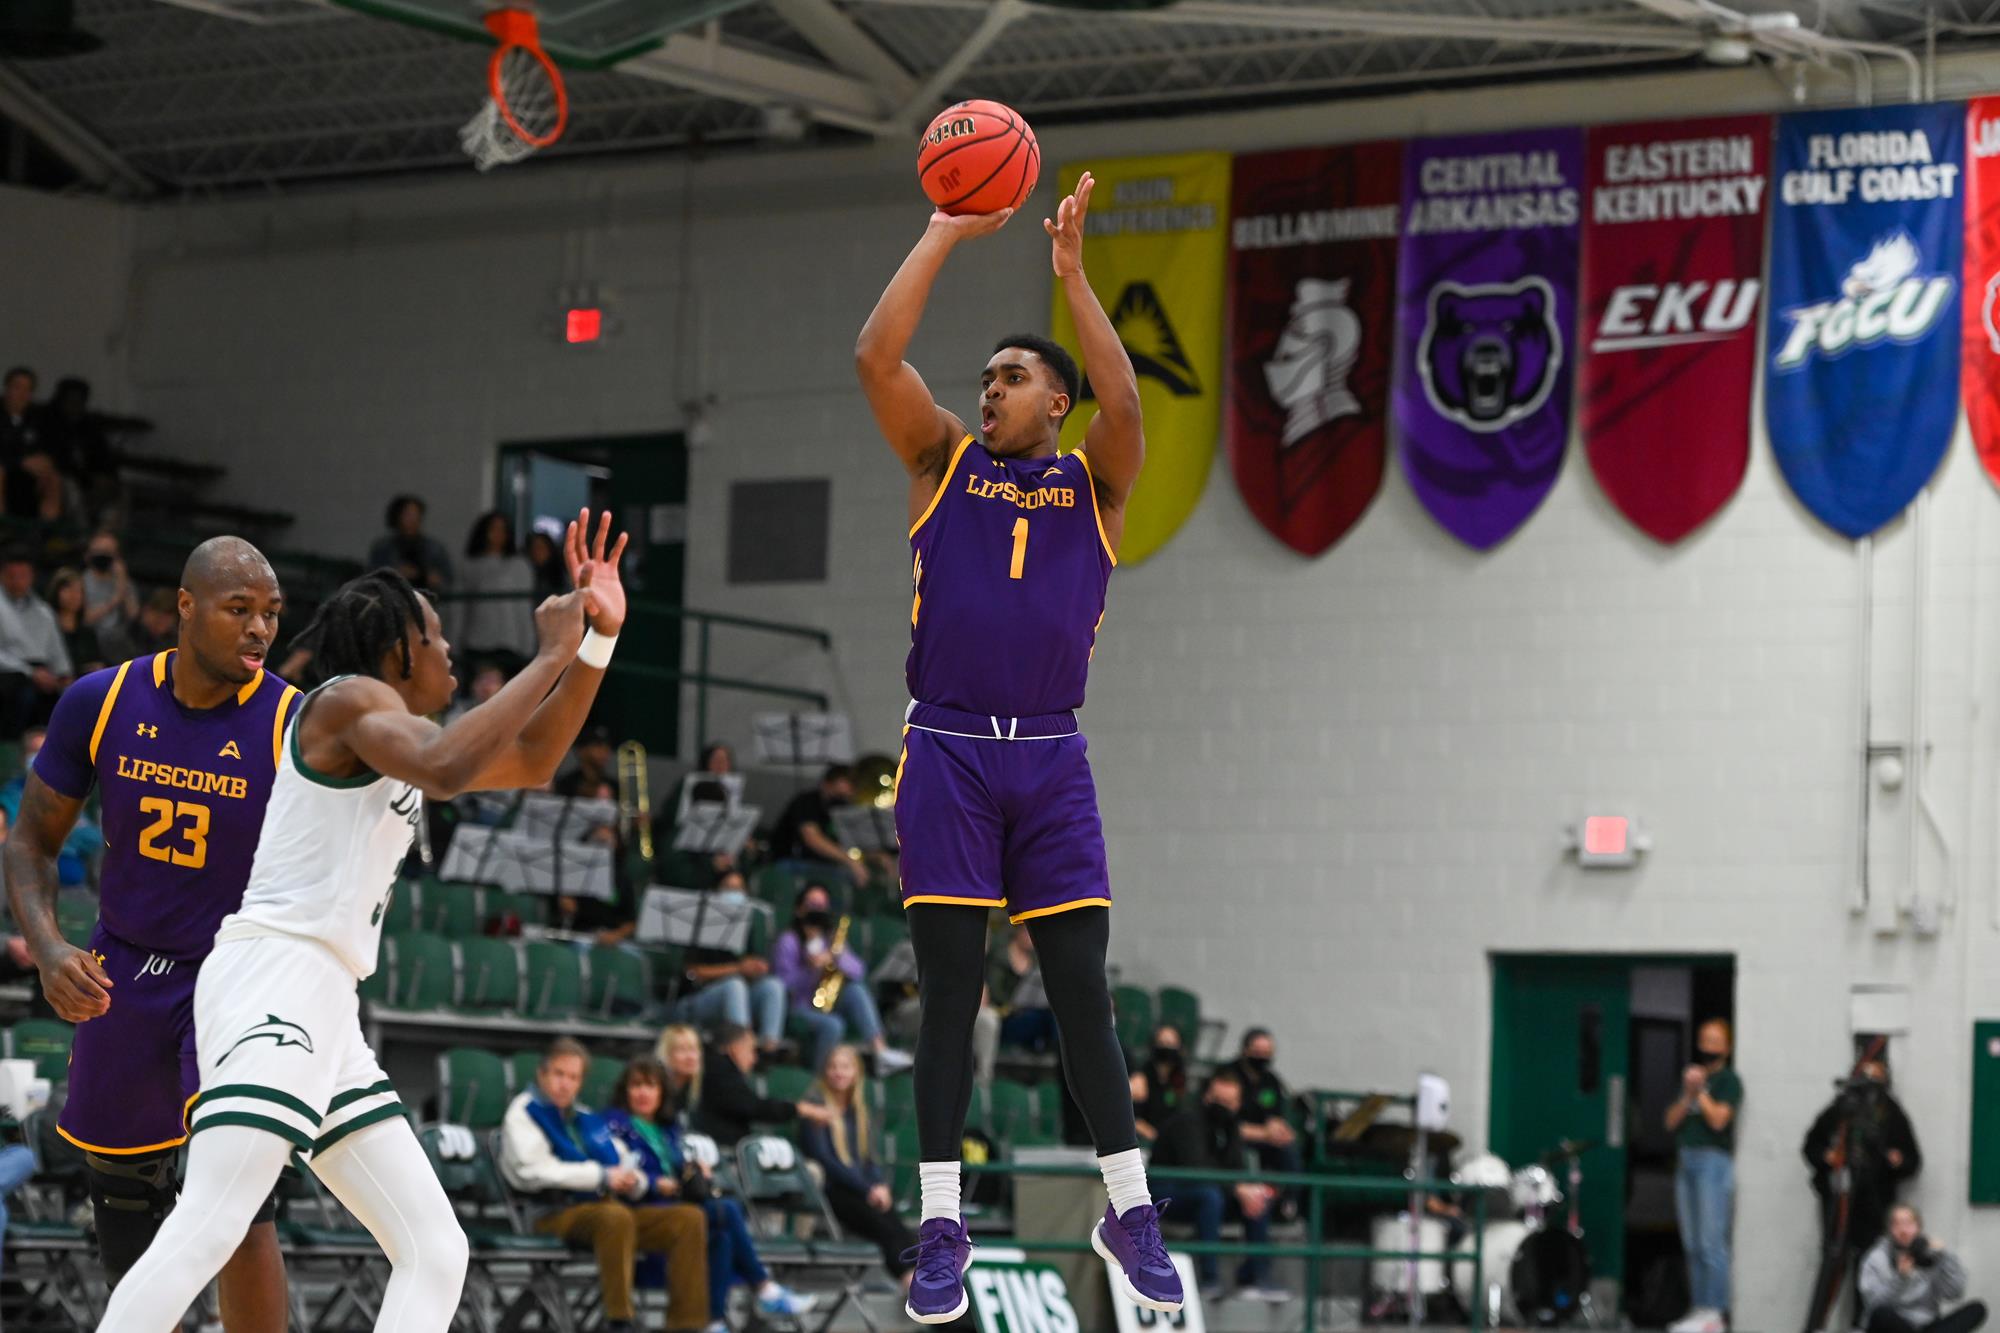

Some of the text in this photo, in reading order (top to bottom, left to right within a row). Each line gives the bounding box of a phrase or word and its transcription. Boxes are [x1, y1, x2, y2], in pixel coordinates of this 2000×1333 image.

[1421, 150, 1566, 194] CENTRAL
[1606, 135, 1753, 183] EASTERN
[1809, 129, 1932, 168] FLORIDA
[1594, 174, 1766, 224] KENTUCKY
[1782, 163, 1958, 206] GULF COAST
[1234, 204, 1398, 250] BELLARMINE
[1407, 187, 1579, 236] ARKANSAS
[1601, 278, 1760, 336] EKU
[1777, 277, 1952, 367] FGCU
[966, 474, 1075, 509] LIPSCOMB
[1009, 517, 1029, 579] 1
[117, 755, 247, 799] LIPSCOMB
[139, 796, 210, 869] 23
[968, 1267, 1080, 1333] FINS
